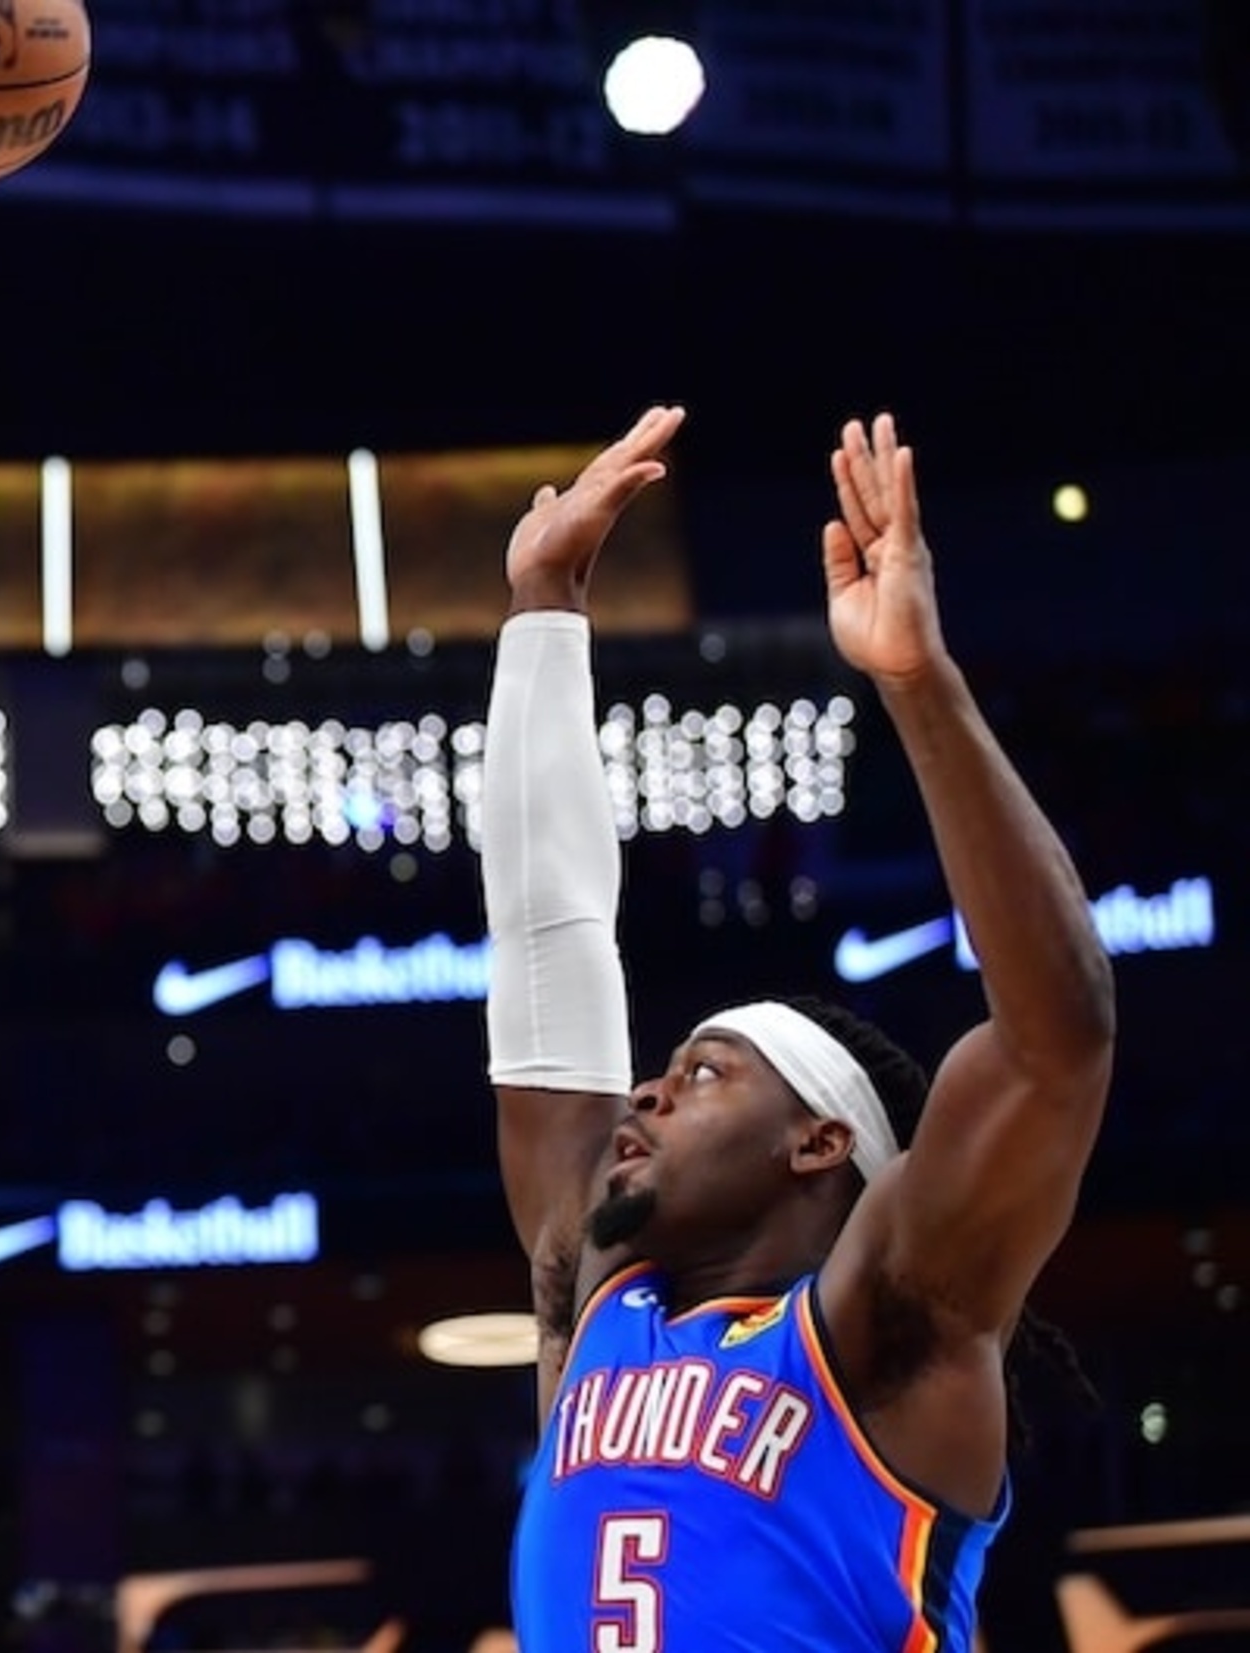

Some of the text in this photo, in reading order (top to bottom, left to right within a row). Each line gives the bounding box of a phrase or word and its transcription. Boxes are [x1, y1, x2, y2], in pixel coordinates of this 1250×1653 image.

[59, 1191, 318, 1271] Basketball
[551, 1354, 814, 1501] THUNDER
[592, 1509, 670, 1653] 5
